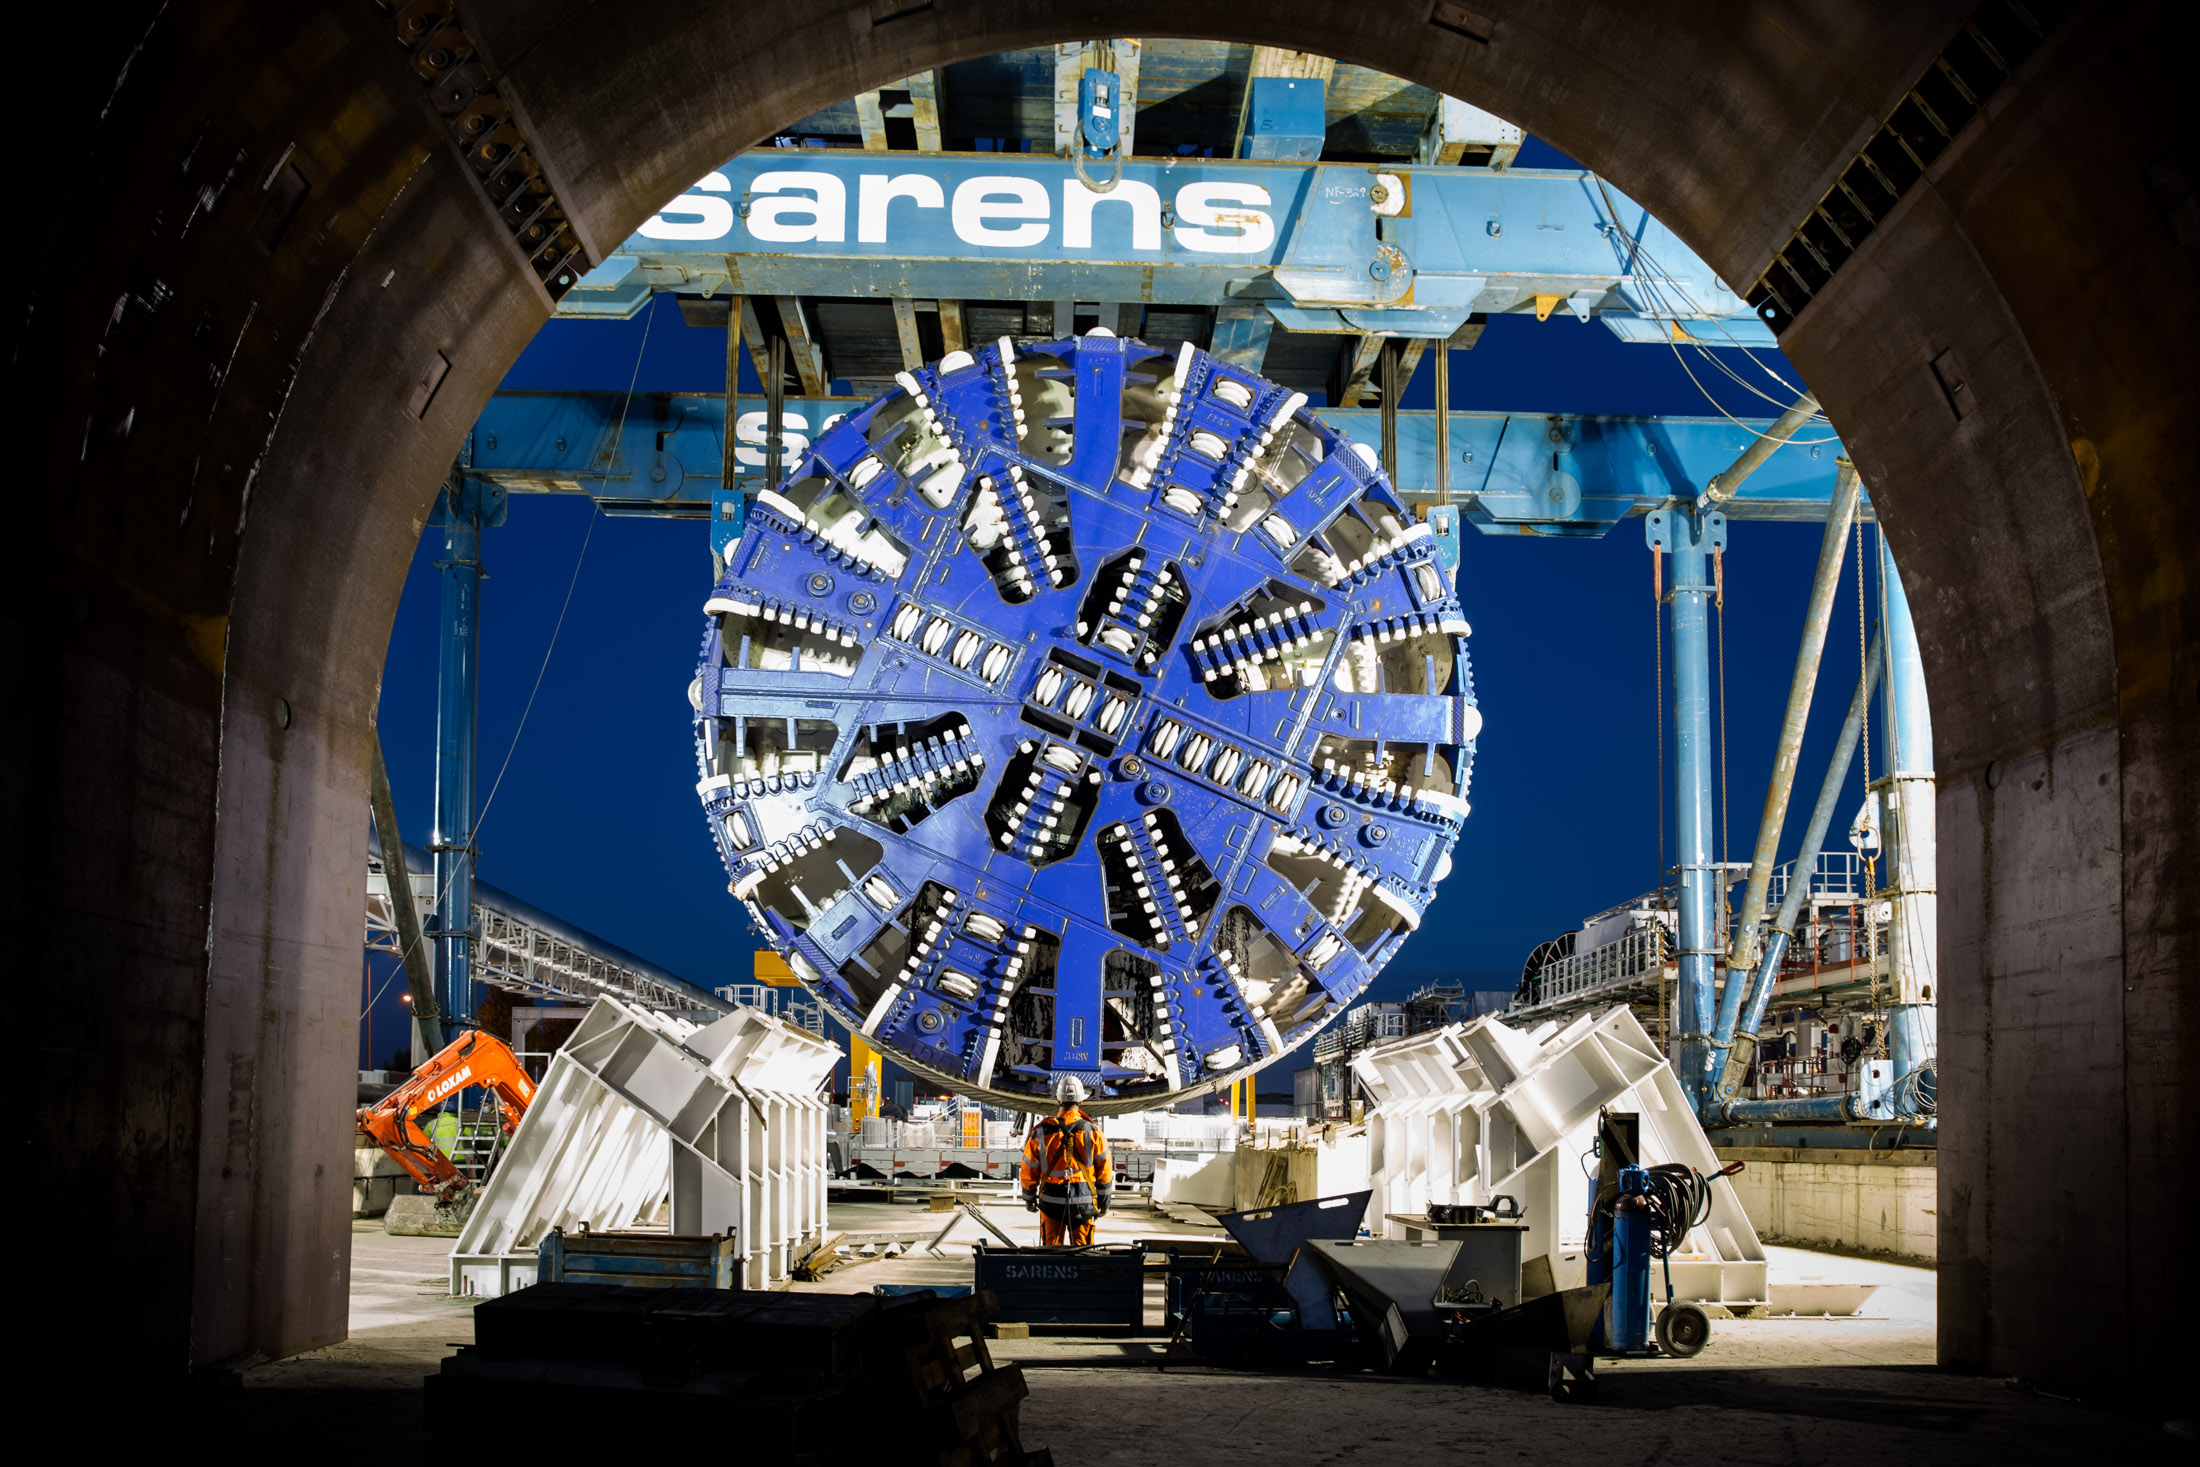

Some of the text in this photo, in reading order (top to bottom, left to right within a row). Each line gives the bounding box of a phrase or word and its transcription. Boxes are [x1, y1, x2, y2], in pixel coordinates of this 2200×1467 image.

[637, 171, 1275, 254] sarens
[435, 1065, 472, 1098] LOXAM
[1005, 1264, 1079, 1279] SARENS
[1200, 1270, 1263, 1282] ARENS
